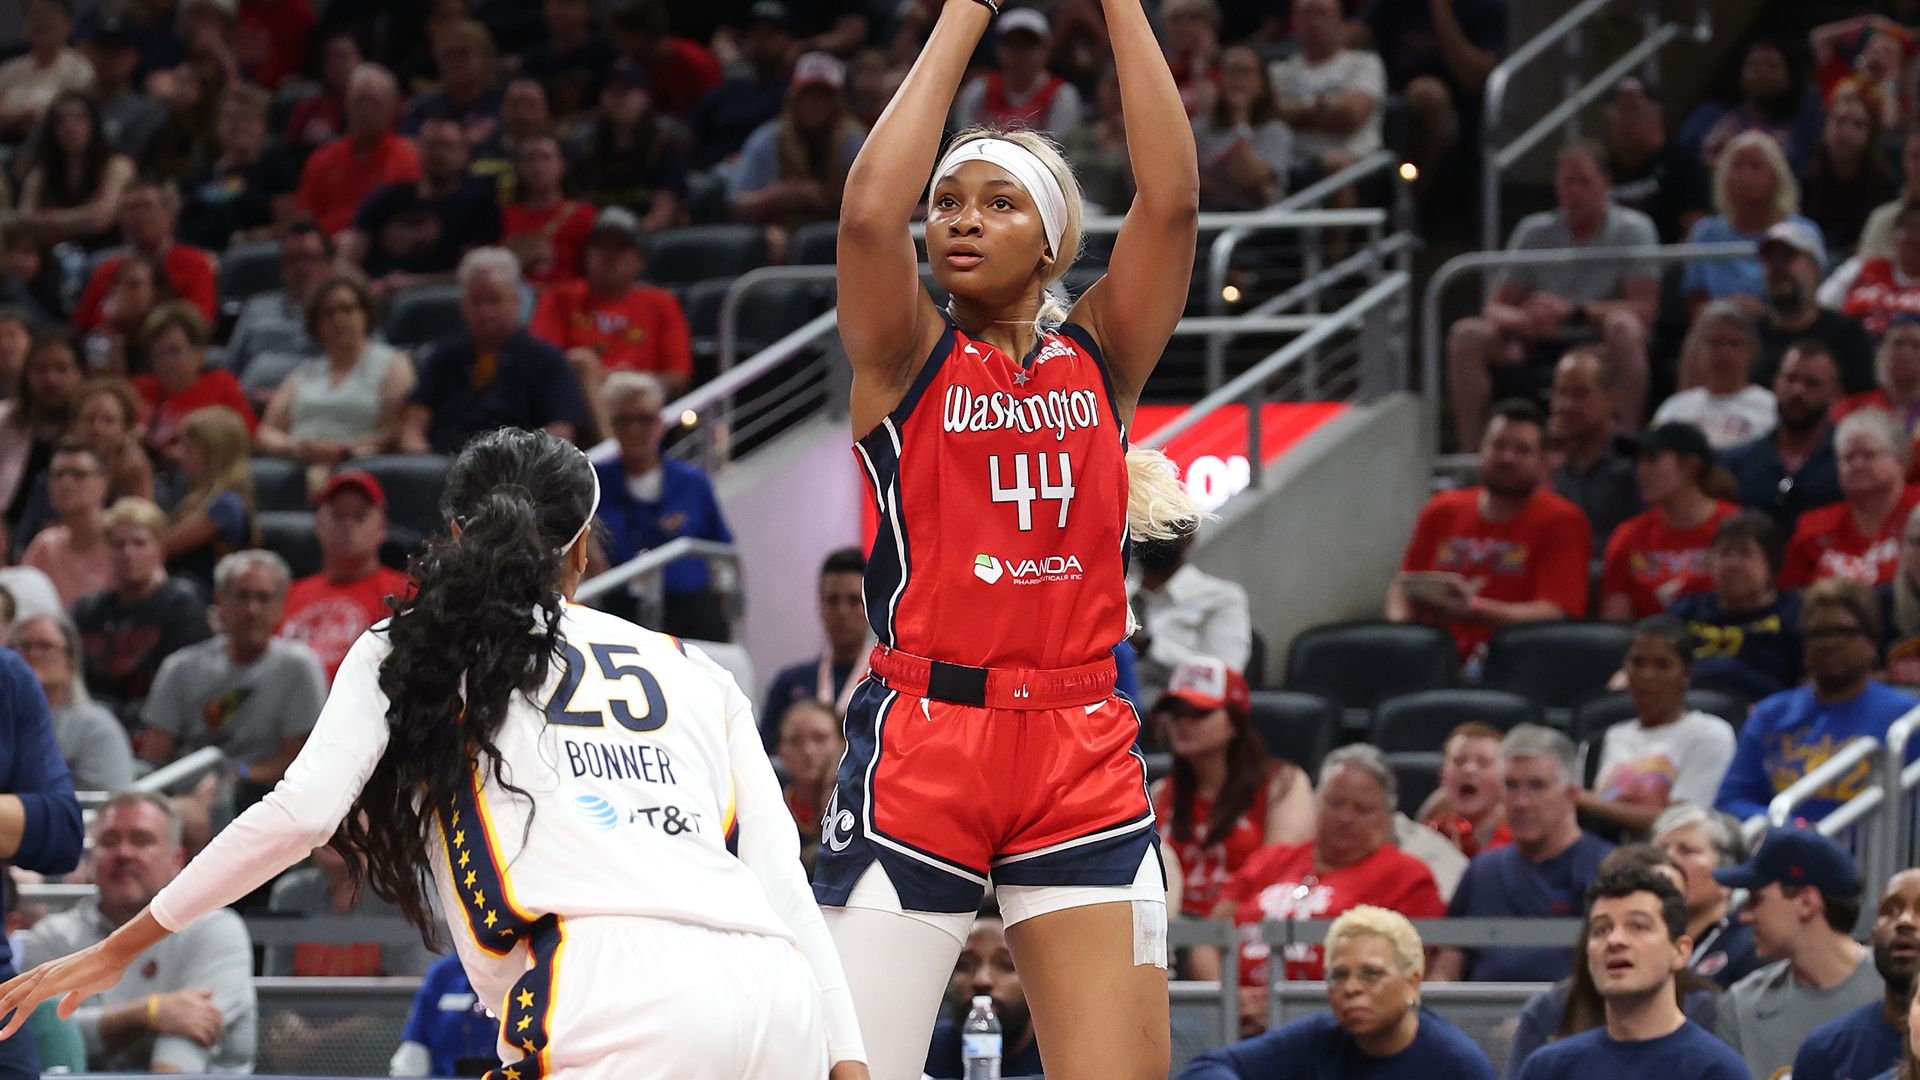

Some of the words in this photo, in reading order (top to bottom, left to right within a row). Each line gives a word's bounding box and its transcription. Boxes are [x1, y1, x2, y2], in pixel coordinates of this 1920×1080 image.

[943, 384, 1099, 441] Washington
[988, 452, 1076, 531] 44
[1005, 555, 1083, 577] VANDA
[546, 642, 668, 732] 25
[565, 741, 676, 784] BONNER
